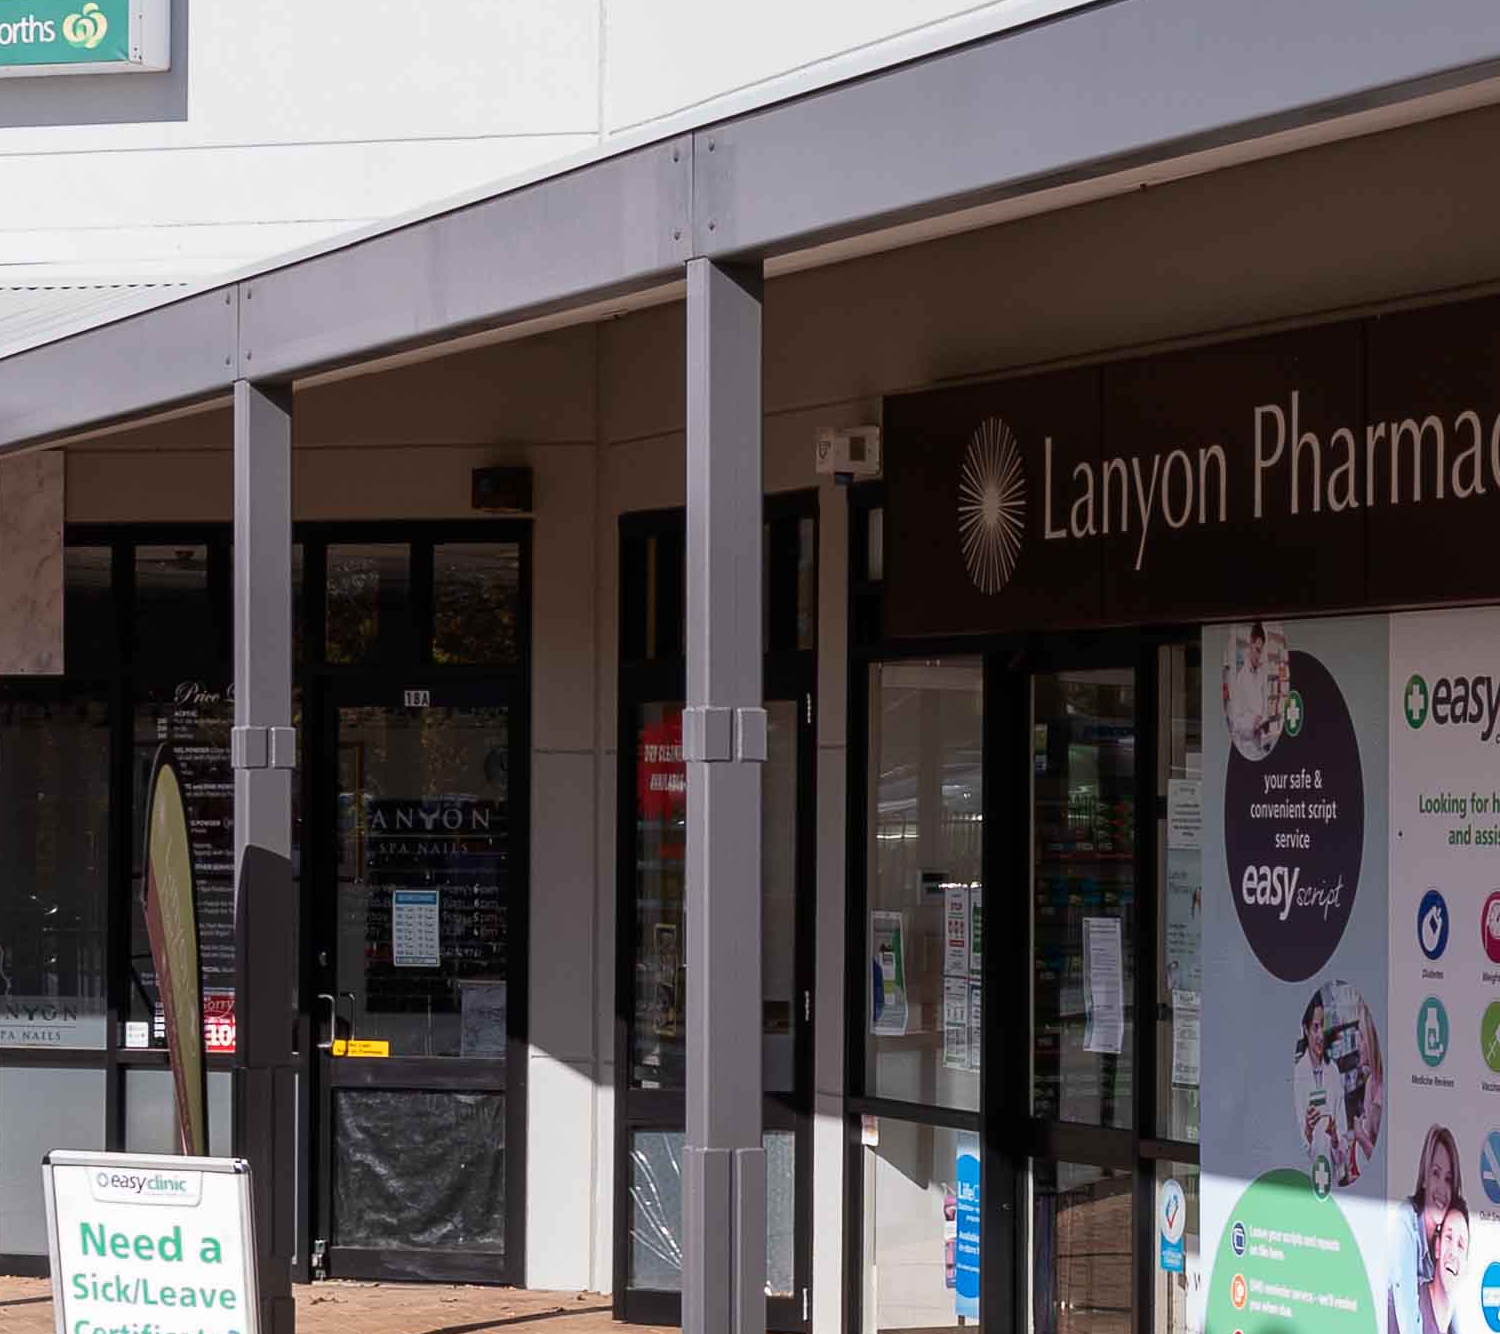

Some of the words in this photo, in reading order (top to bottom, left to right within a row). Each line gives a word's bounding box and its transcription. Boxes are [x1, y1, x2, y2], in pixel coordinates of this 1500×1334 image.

[1044, 436, 1227, 571] Lanyon
[1264, 772, 1288, 794] your
[1290, 768, 1312, 790] safe
[1314, 769, 1322, 789] &
[1250, 801, 1305, 820] convenient
[1308, 801, 1337, 824] script
[1419, 794, 1466, 818] Looking
[1471, 793, 1488, 814] for
[1275, 829, 1310, 849] service
[1449, 826, 1471, 846] and
[4, 1003, 76, 1021] NYON
[0, 1030, 15, 1040] PA
[22, 1031, 61, 1041] NAILS
[80, 1222, 182, 1263] Need
[200, 1236, 222, 1264] a
[73, 1273, 236, 1310] Sick/Leave
